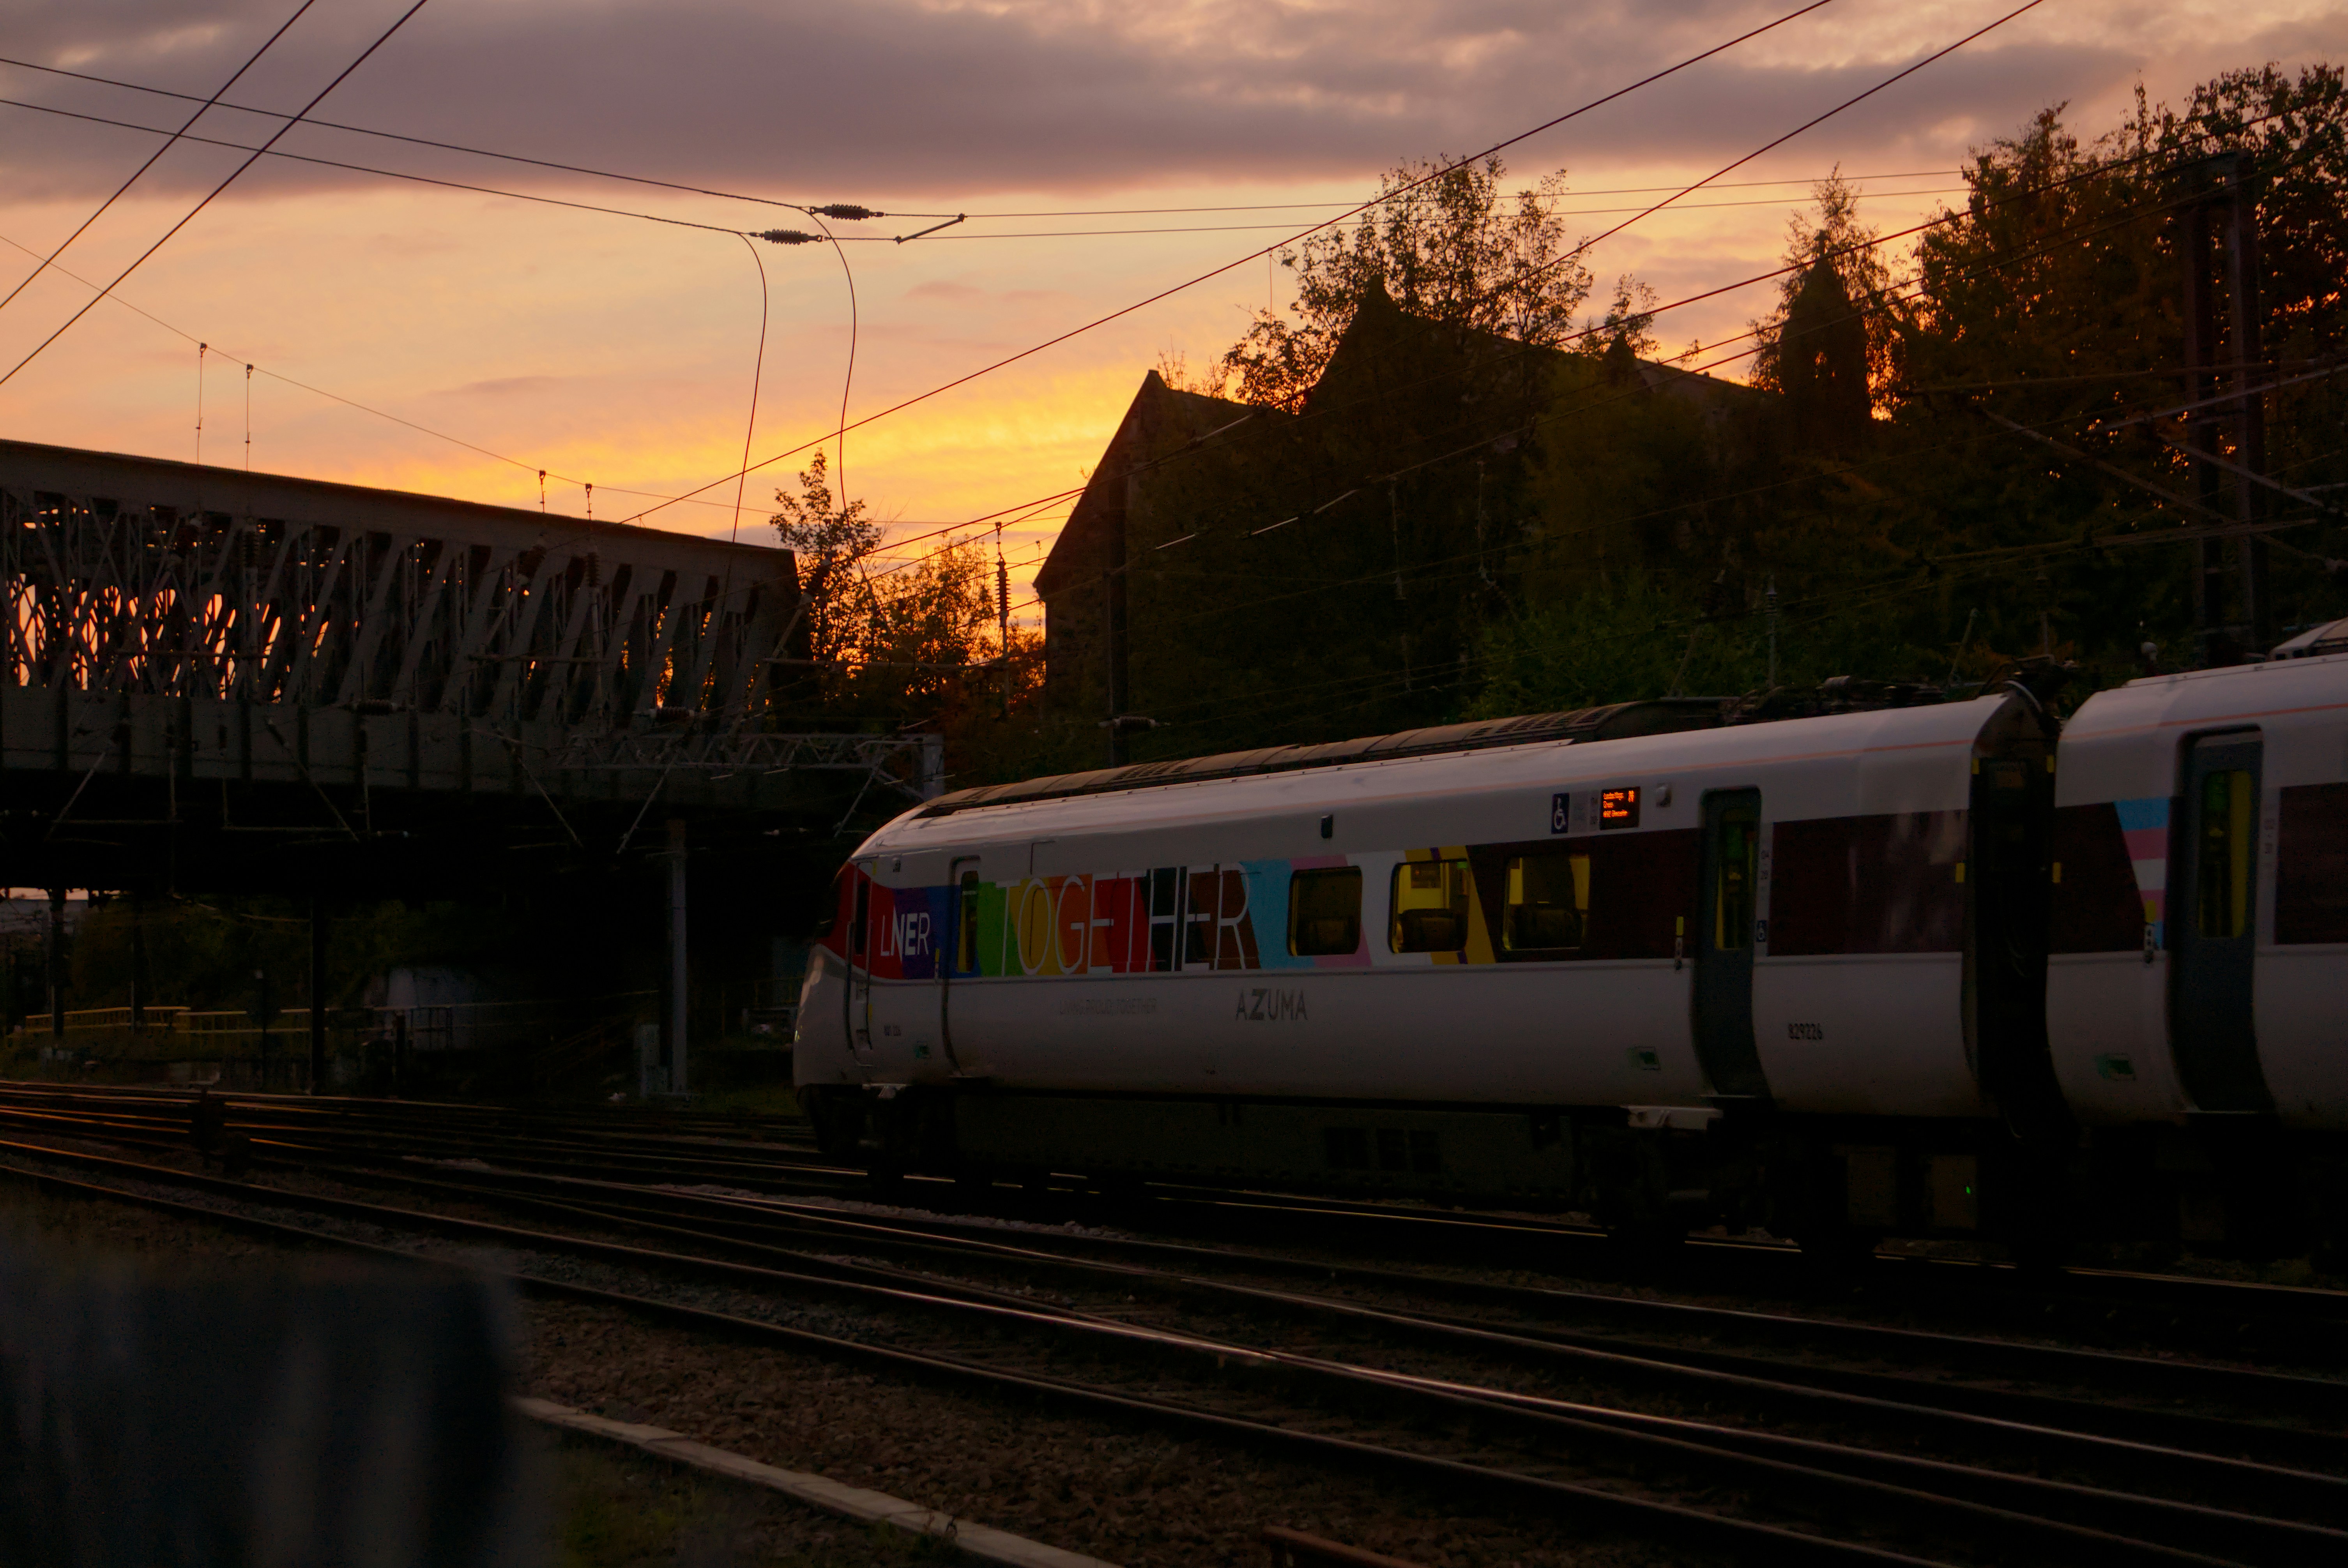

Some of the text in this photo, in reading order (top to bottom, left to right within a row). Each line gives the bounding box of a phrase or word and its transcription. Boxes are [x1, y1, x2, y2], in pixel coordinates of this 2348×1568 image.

[880, 906, 931, 962] LNER
[996, 862, 1249, 976] TOGETHER
[1235, 989, 1308, 1020] AZUMA
